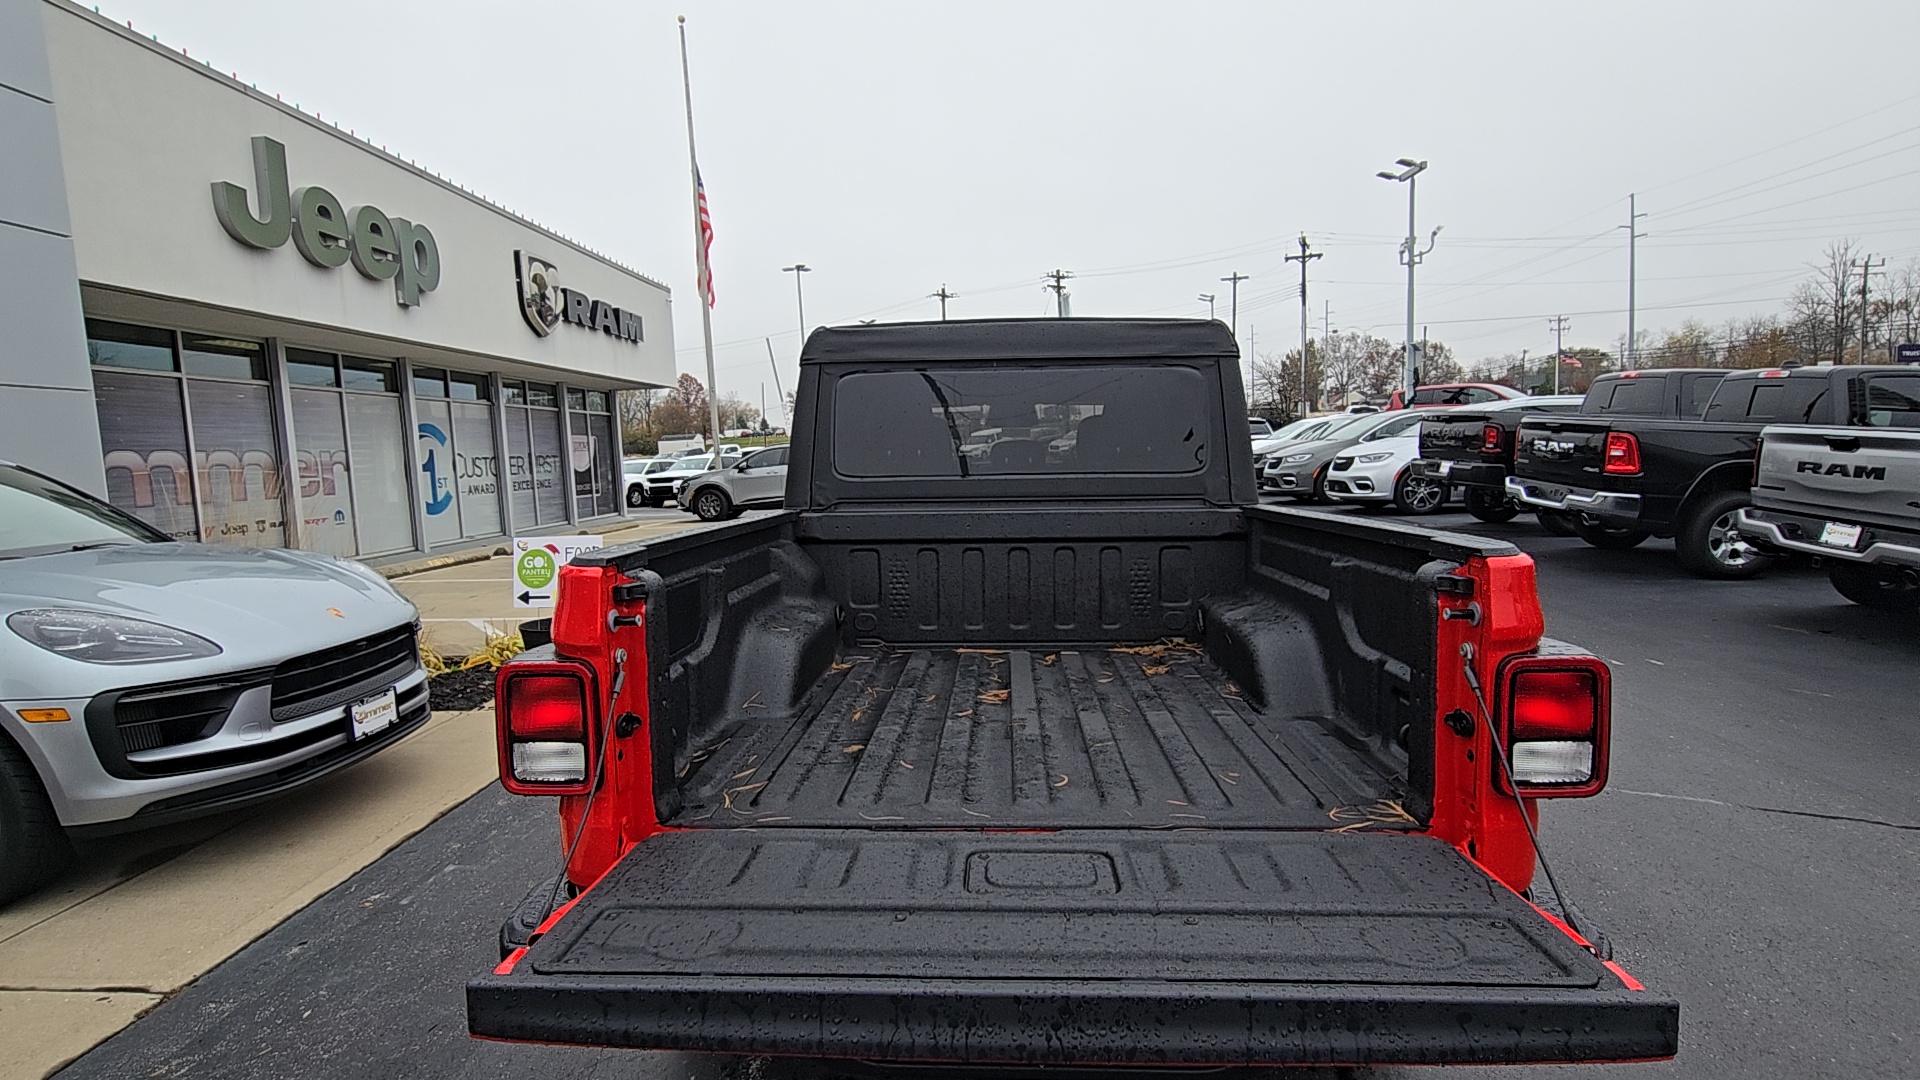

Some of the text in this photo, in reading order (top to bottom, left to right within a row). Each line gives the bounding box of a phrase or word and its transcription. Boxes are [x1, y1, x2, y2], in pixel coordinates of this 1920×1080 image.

[211, 136, 441, 307] Jeep
[560, 287, 645, 344] RAM
[1533, 439, 1575, 454] RAM
[1797, 461, 1886, 480] RAM
[467, 479, 552, 496] AWARD EXCELENCE
[221, 522, 249, 536] Jeep
[304, 517, 329, 526] SRT
[523, 556, 548, 569] GO!
